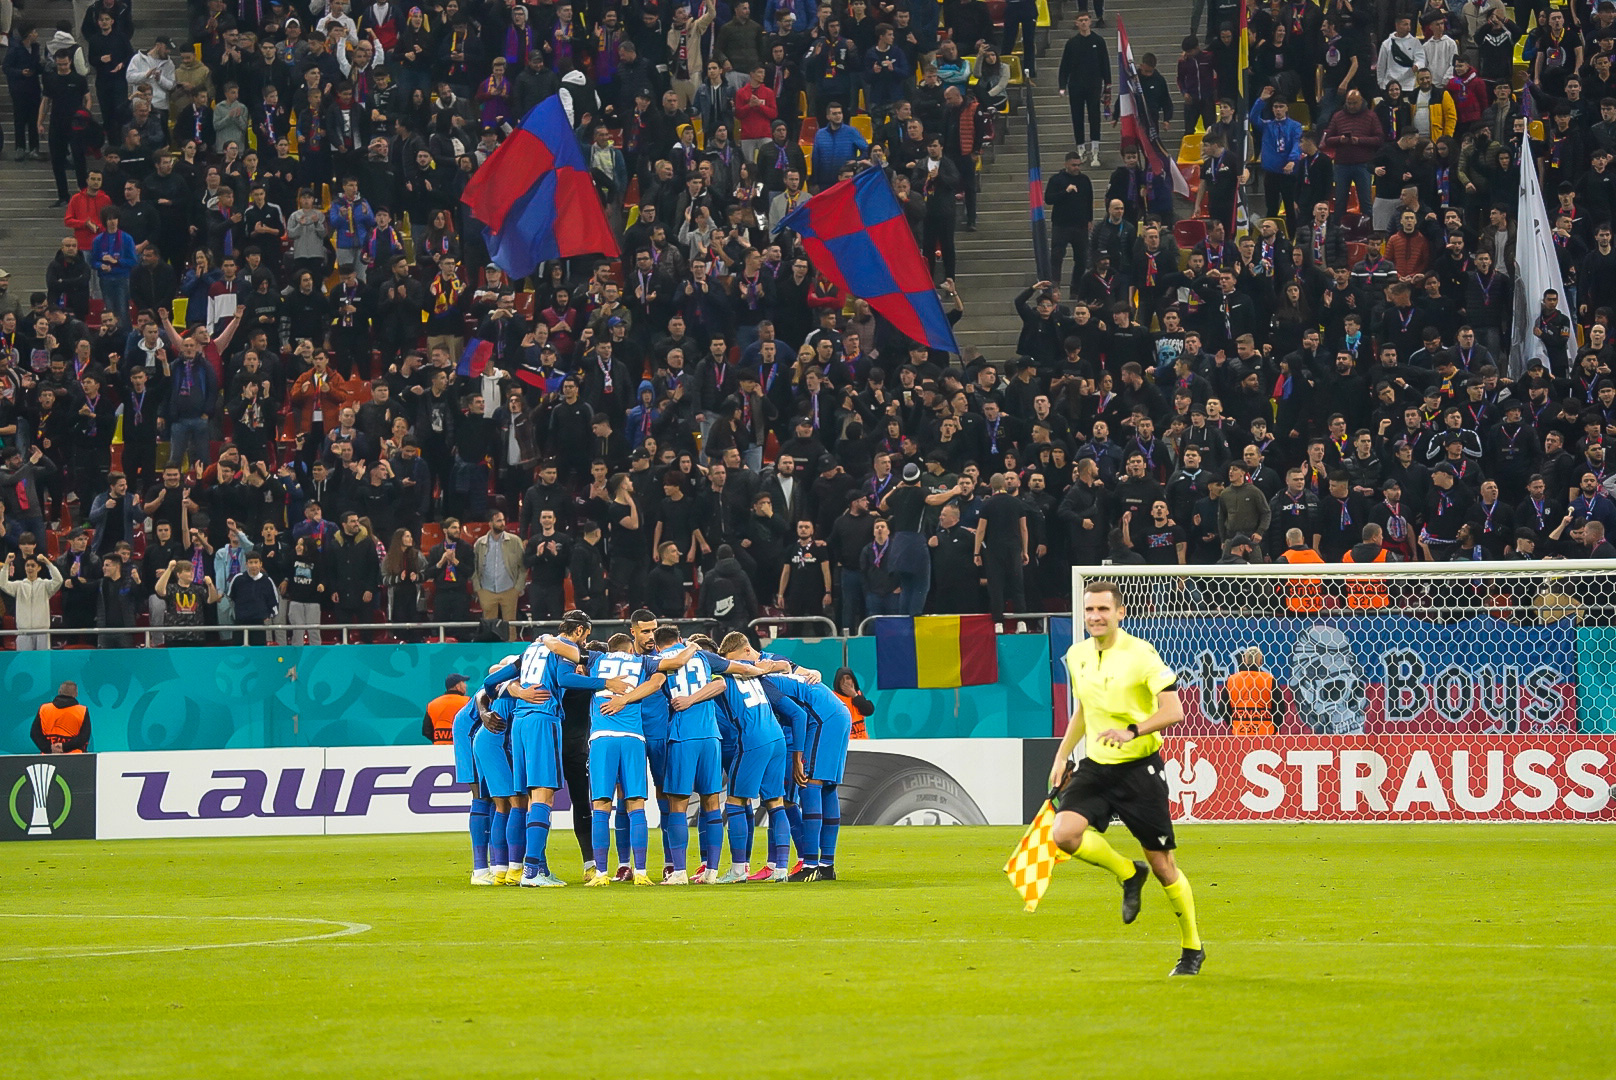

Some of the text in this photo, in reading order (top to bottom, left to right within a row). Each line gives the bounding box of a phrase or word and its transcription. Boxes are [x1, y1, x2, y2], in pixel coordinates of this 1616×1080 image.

[667, 657, 708, 699] 33
[1382, 647, 1565, 735] Boys
[1239, 749, 1611, 813] STRAUSS
